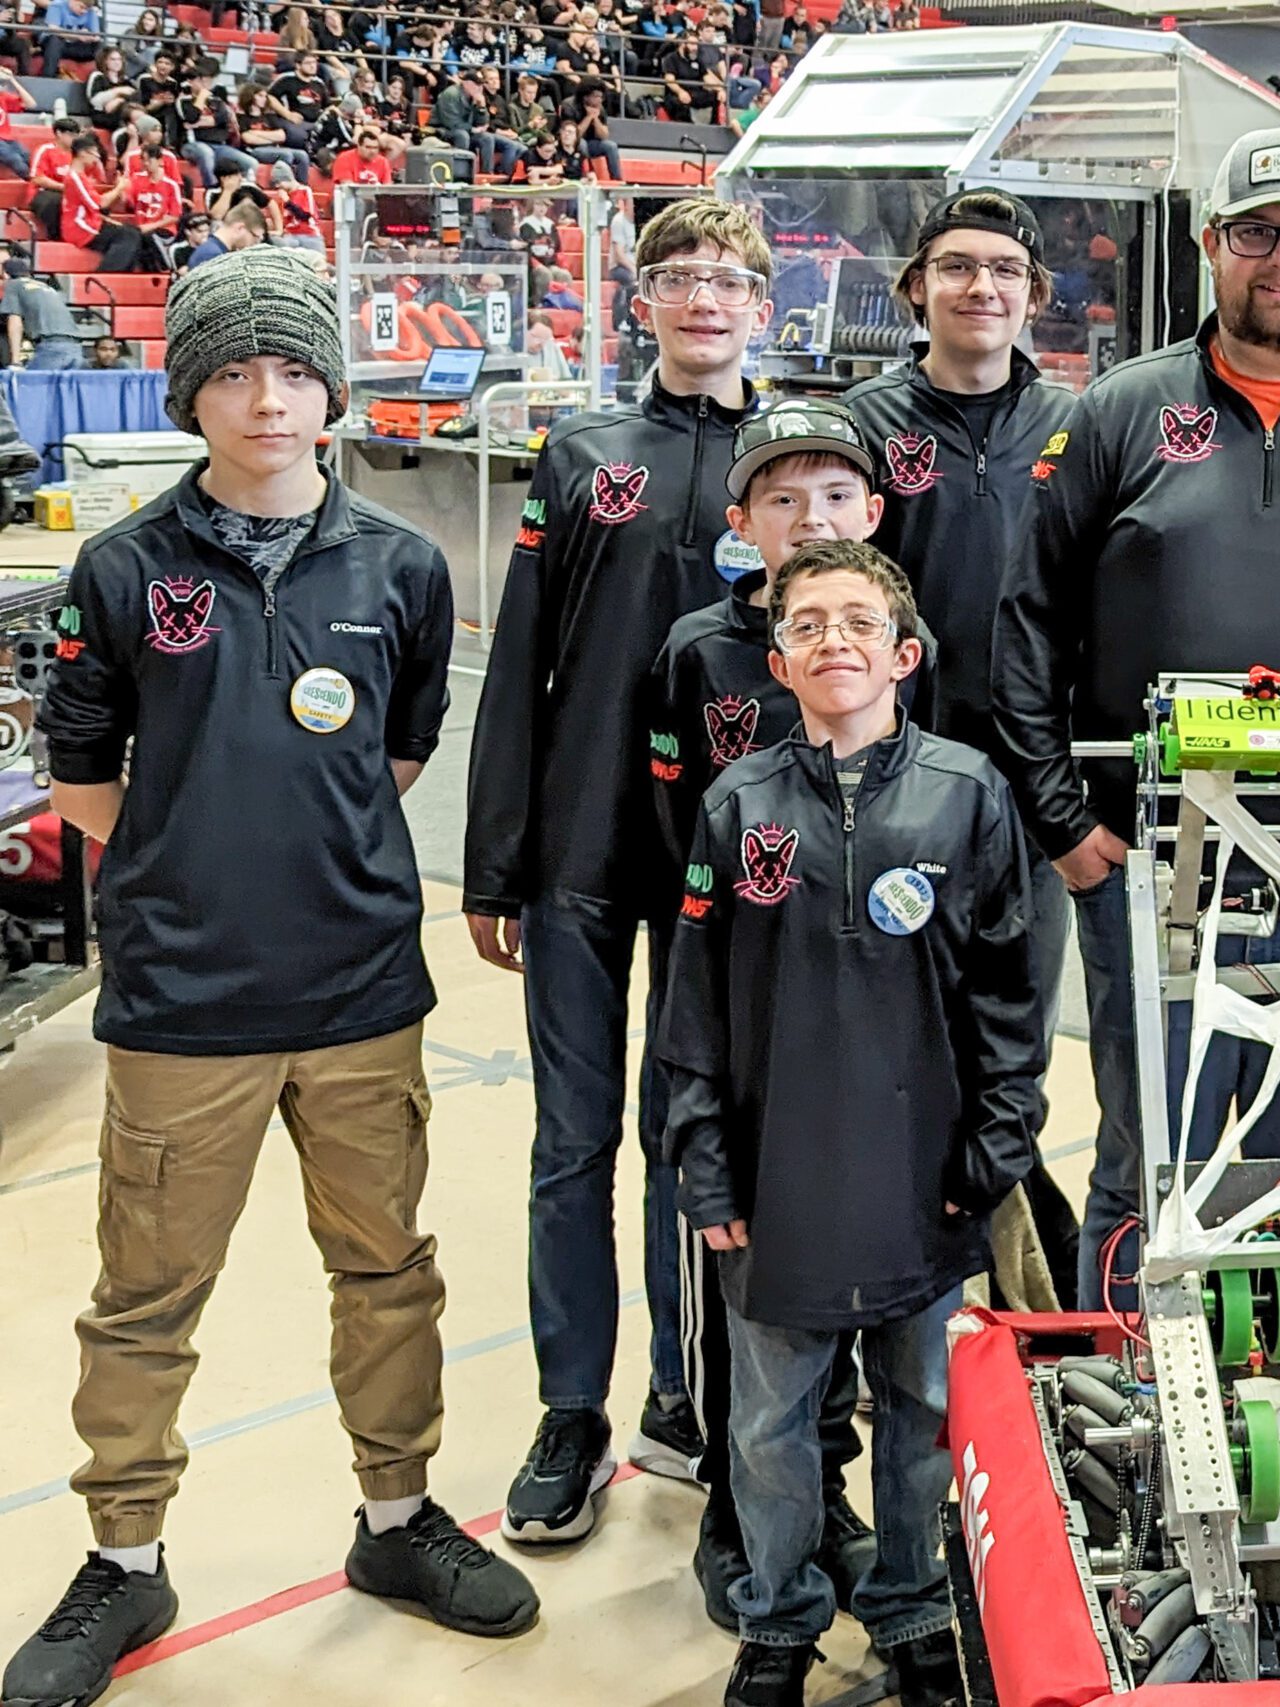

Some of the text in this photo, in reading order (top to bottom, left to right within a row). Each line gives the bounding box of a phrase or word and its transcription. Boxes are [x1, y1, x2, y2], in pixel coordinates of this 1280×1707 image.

[330, 622, 382, 634] O'Connor
[303, 686, 346, 709] CRESCENDO
[308, 710, 332, 720] SAFETY
[1187, 700, 1193, 719] I
[1186, 736, 1229, 748] HAAS
[916, 862, 947, 874] White
